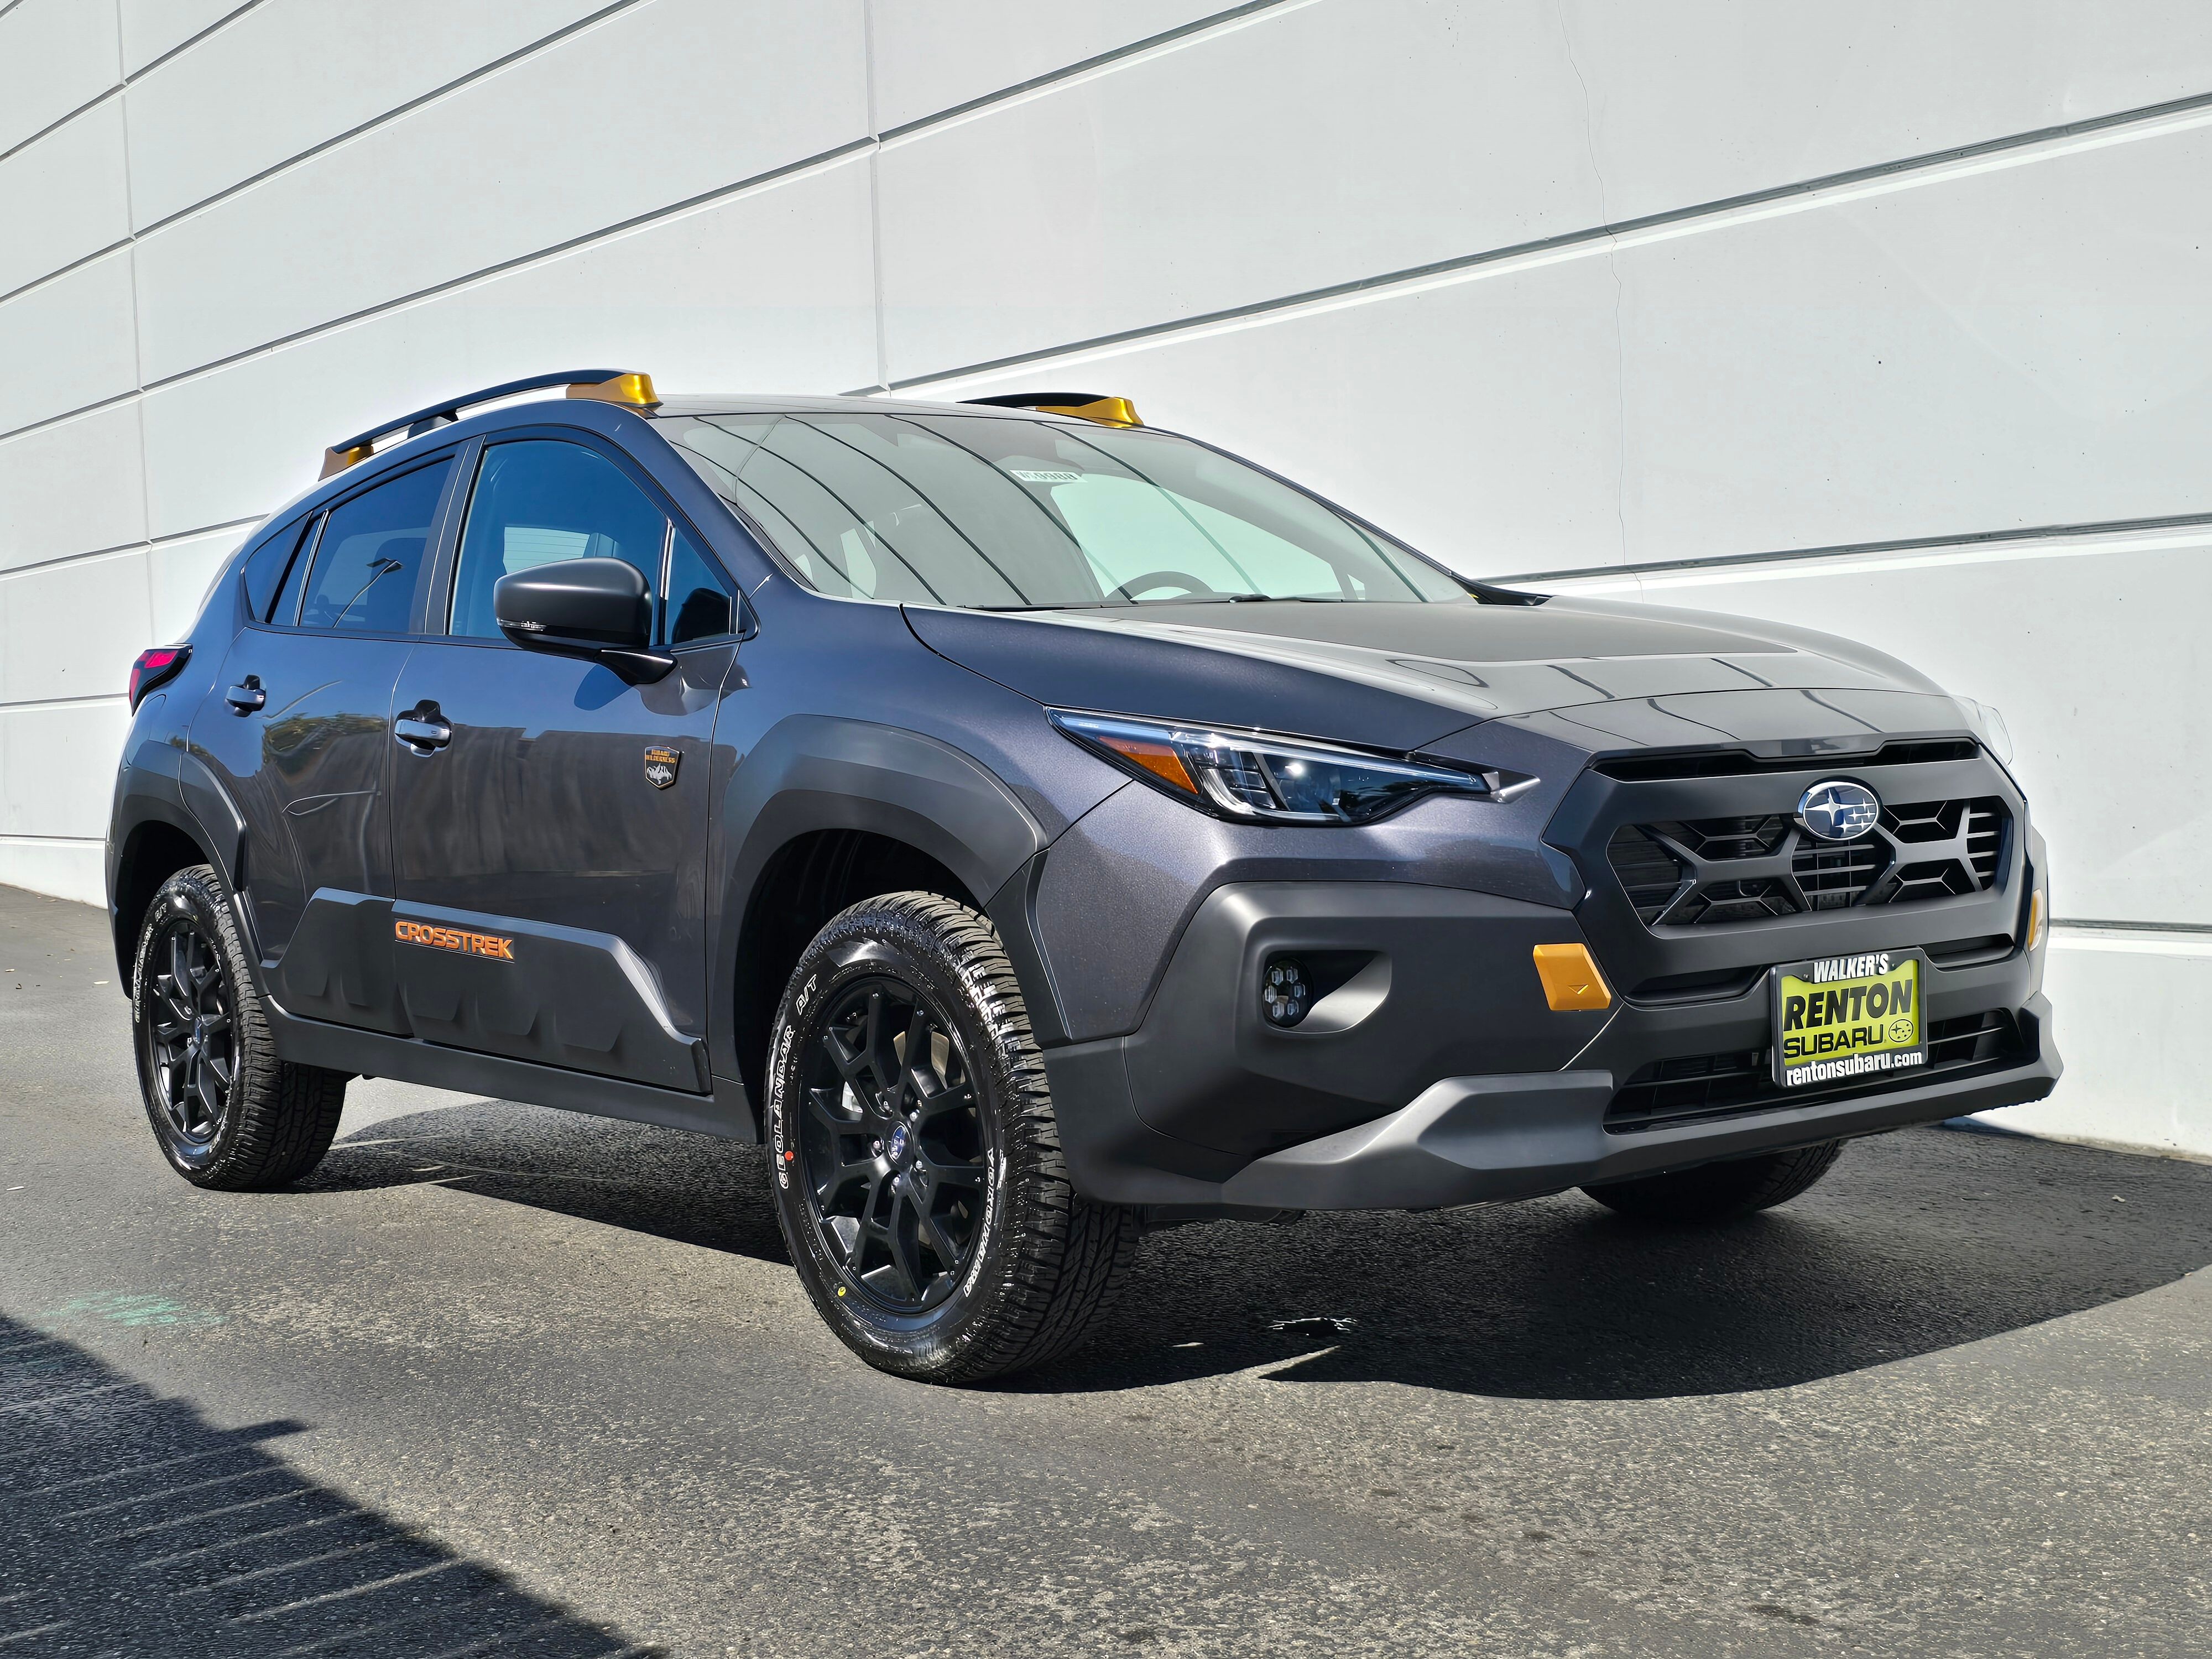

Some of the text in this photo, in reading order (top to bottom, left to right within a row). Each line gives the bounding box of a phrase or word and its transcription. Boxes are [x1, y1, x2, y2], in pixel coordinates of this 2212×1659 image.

[395, 921, 513, 959] CROSSTREK
[1814, 953, 1888, 983] WALKER'S
[1783, 979, 1913, 1032] RENTON
[1783, 1024, 1885, 1058] SUBARU
[774, 974, 817, 1189] GEOLANDAR A/T
[1786, 1052, 1922, 1086] rentonsubaru.com
